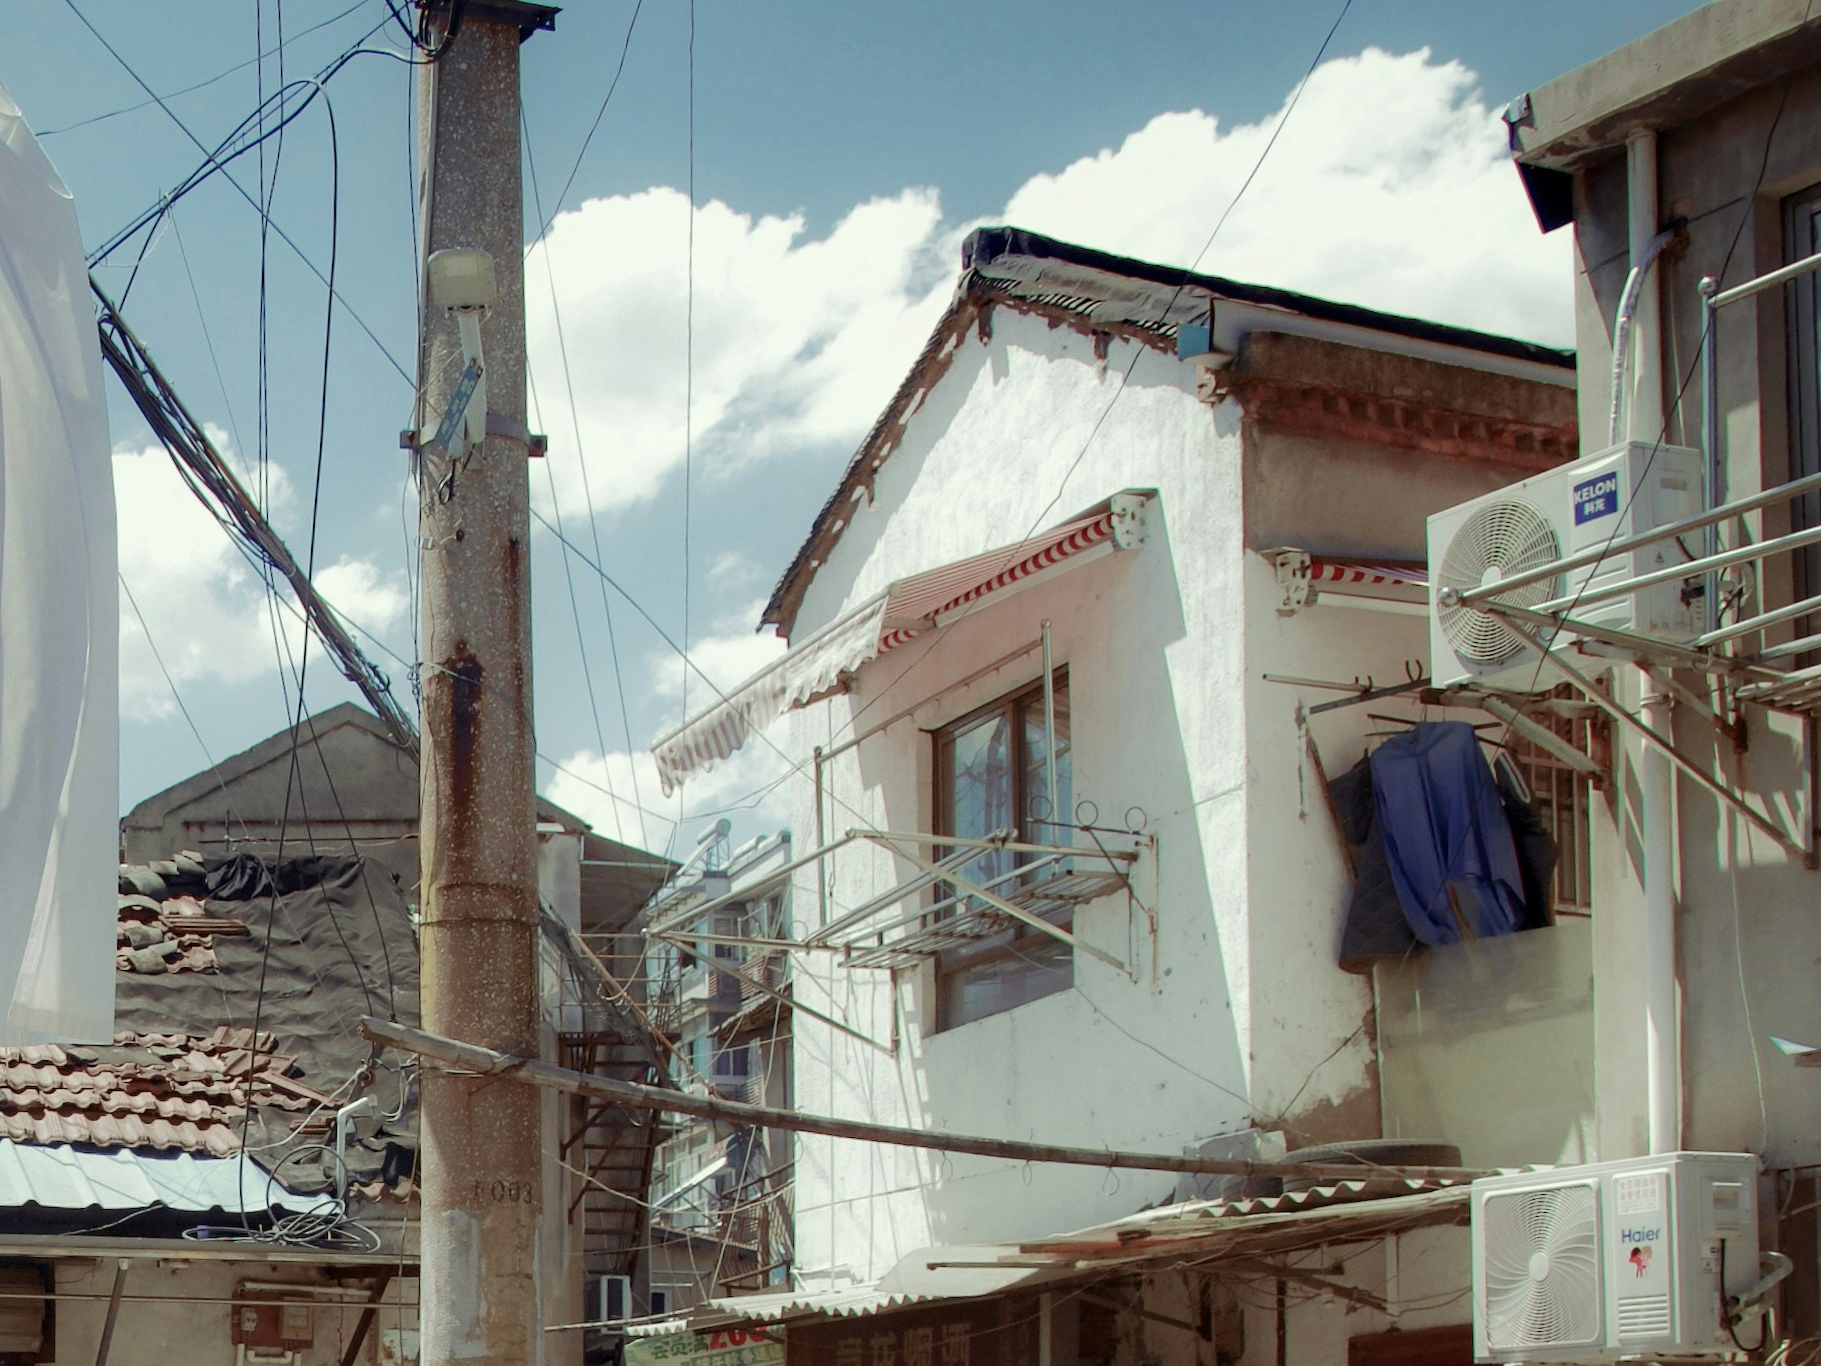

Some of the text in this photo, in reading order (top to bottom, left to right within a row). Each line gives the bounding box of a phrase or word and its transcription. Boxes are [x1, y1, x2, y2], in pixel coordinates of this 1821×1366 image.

[1574, 478, 1616, 505] KELON
[1583, 498, 1605, 515] 科龙
[1620, 1226, 1660, 1243] Haier
